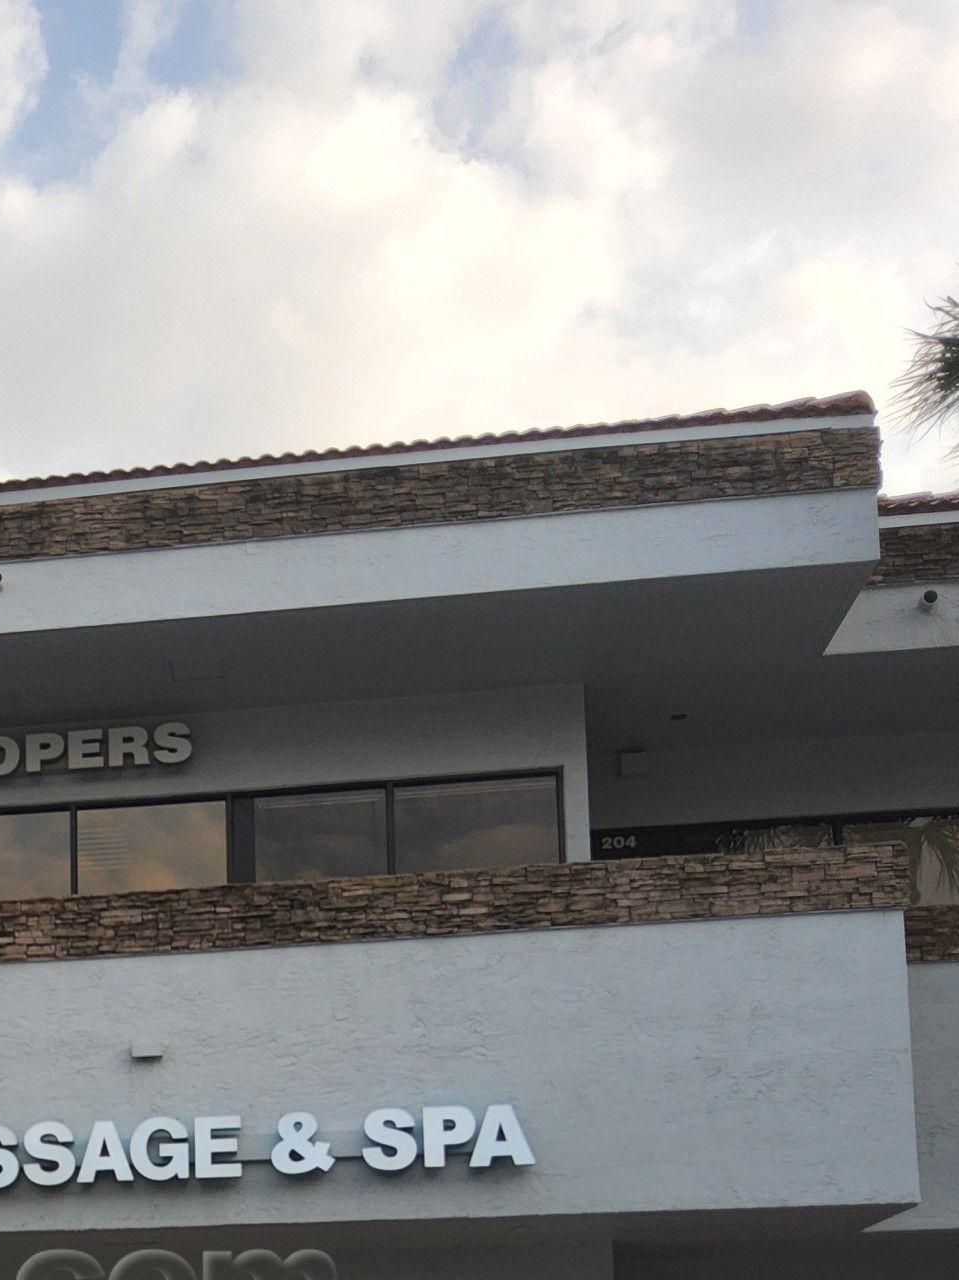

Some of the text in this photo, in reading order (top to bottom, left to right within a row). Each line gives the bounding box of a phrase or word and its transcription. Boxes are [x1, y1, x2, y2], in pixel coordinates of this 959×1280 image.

[601, 835, 637, 849] 204
[271, 1111, 336, 1175] &
[361, 1104, 536, 1172] SPA
